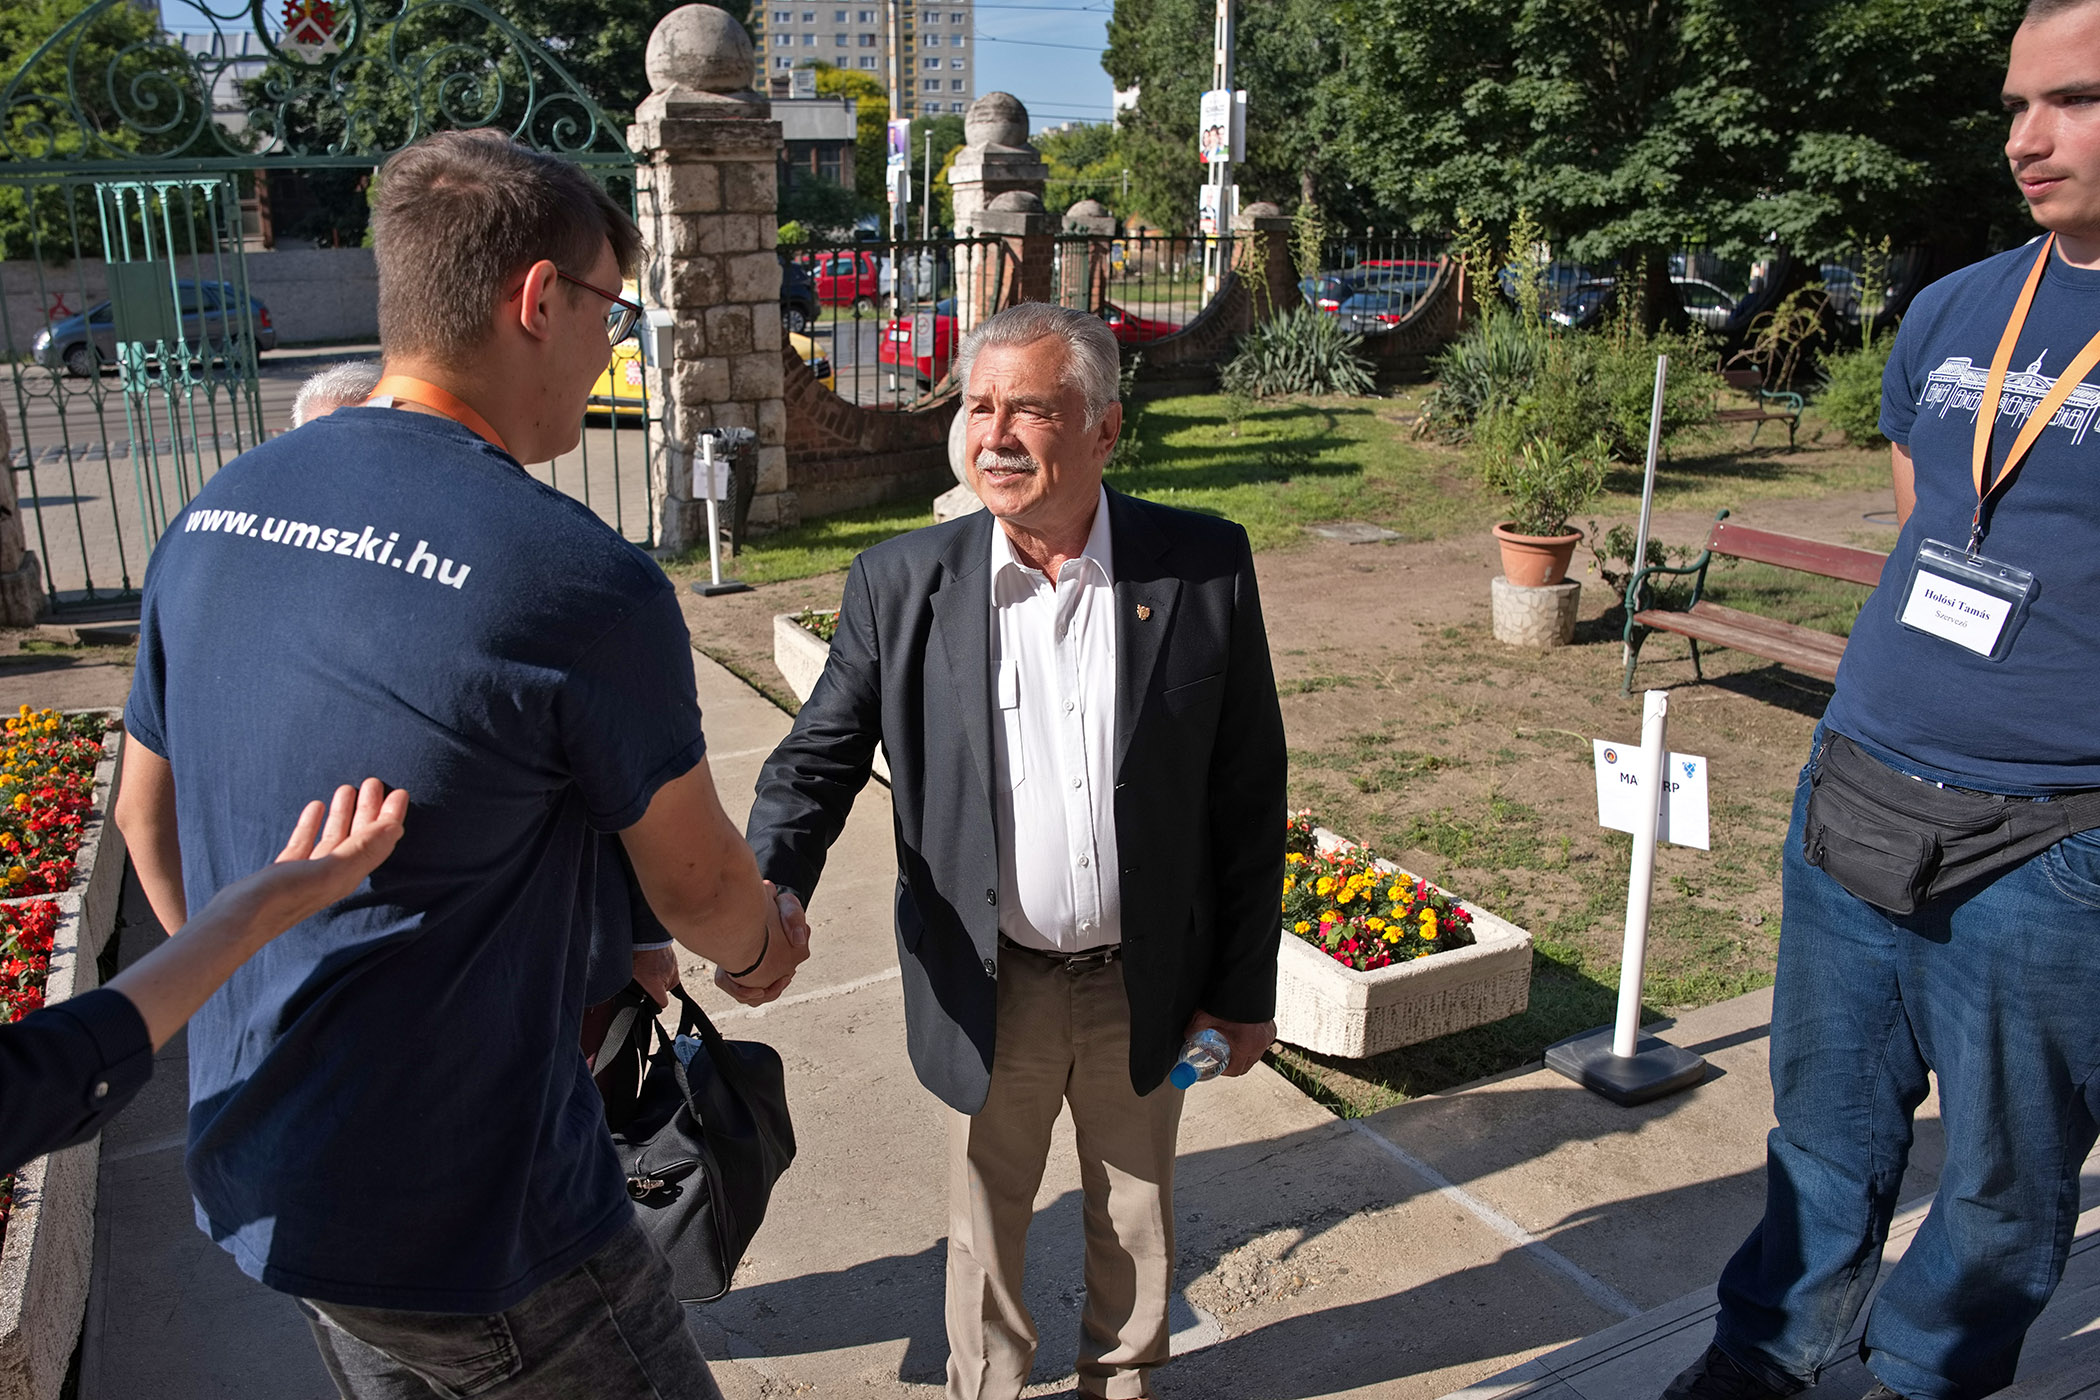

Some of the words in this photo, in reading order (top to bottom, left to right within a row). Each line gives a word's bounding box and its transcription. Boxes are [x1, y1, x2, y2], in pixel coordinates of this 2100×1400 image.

[185, 509, 472, 589] www.umszki.hu
[1925, 588, 1956, 607] Holósi
[1958, 600, 1991, 620] Tamás
[1935, 610, 1968, 628] Szervező
